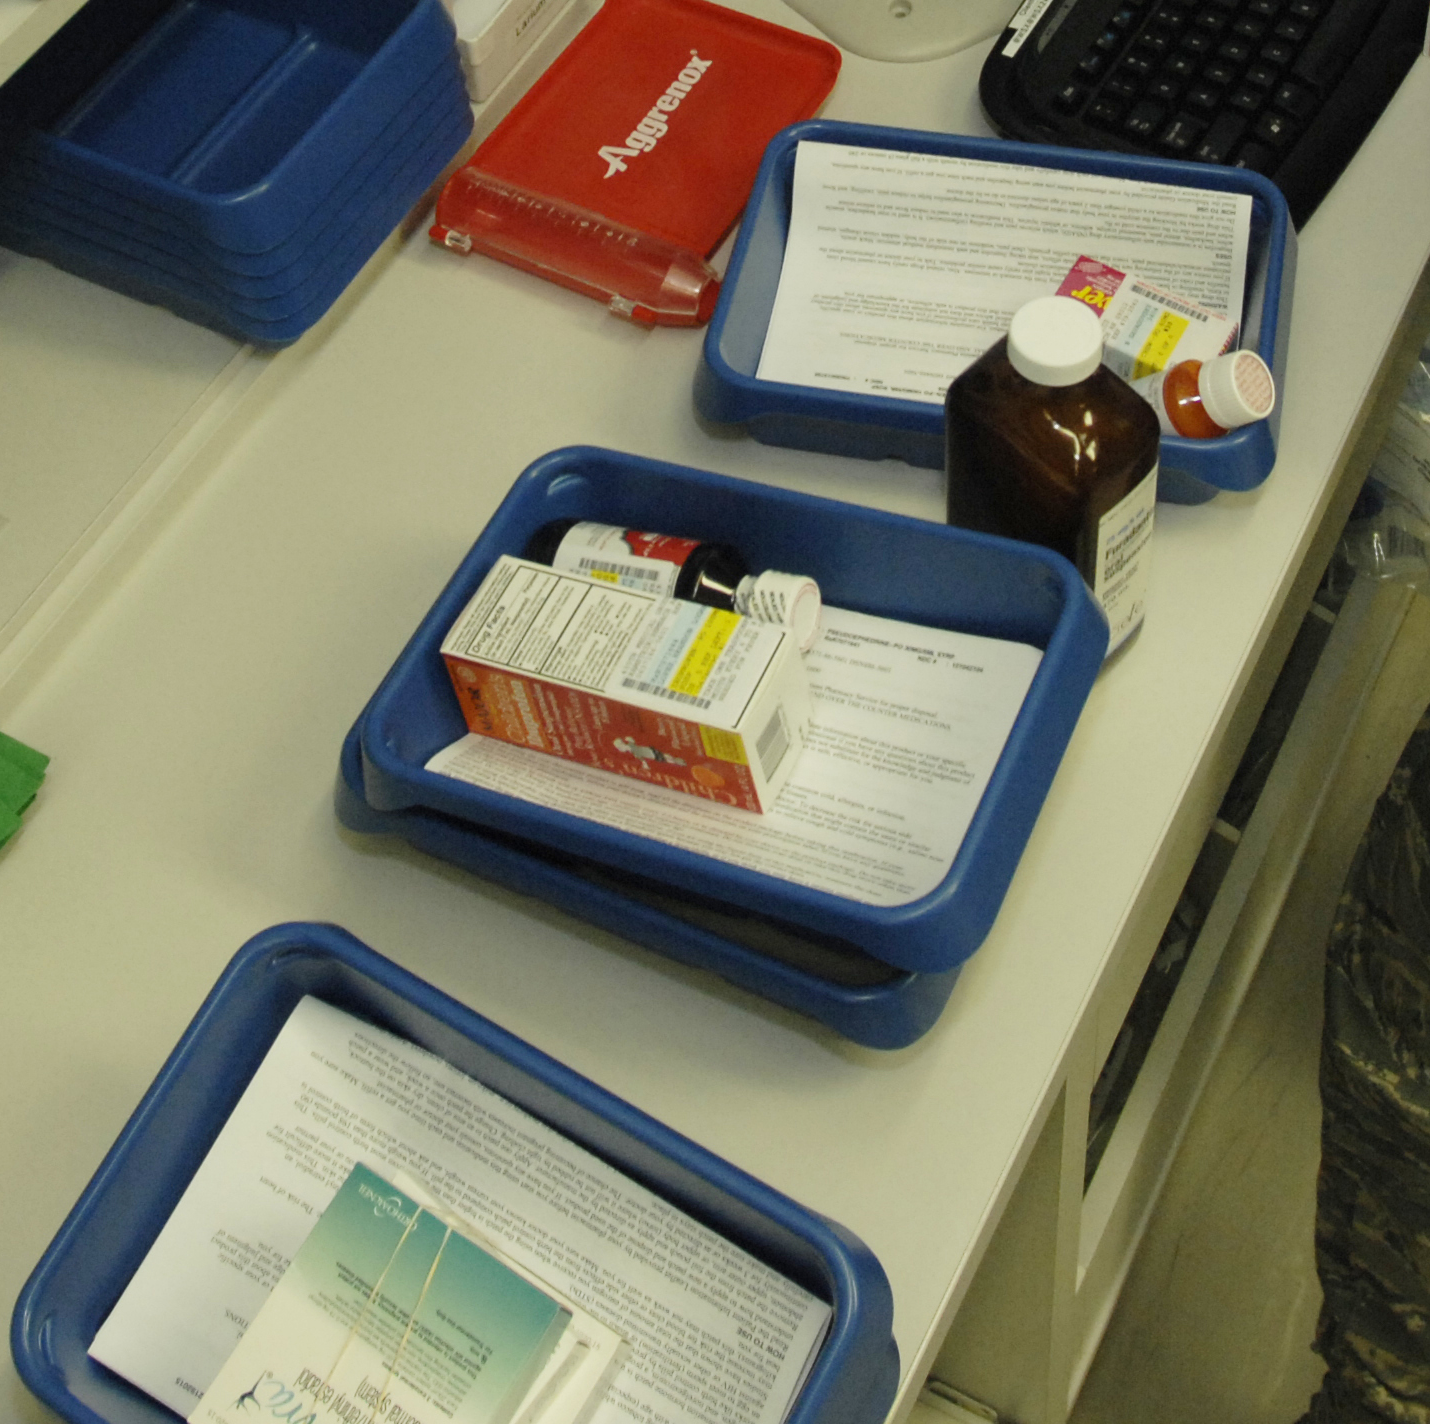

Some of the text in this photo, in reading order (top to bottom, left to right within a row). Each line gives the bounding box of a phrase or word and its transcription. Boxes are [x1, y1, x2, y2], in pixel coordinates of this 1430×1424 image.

[597, 60, 712, 180] Aggrenox
[472, 604, 507, 654] Drug Facts
